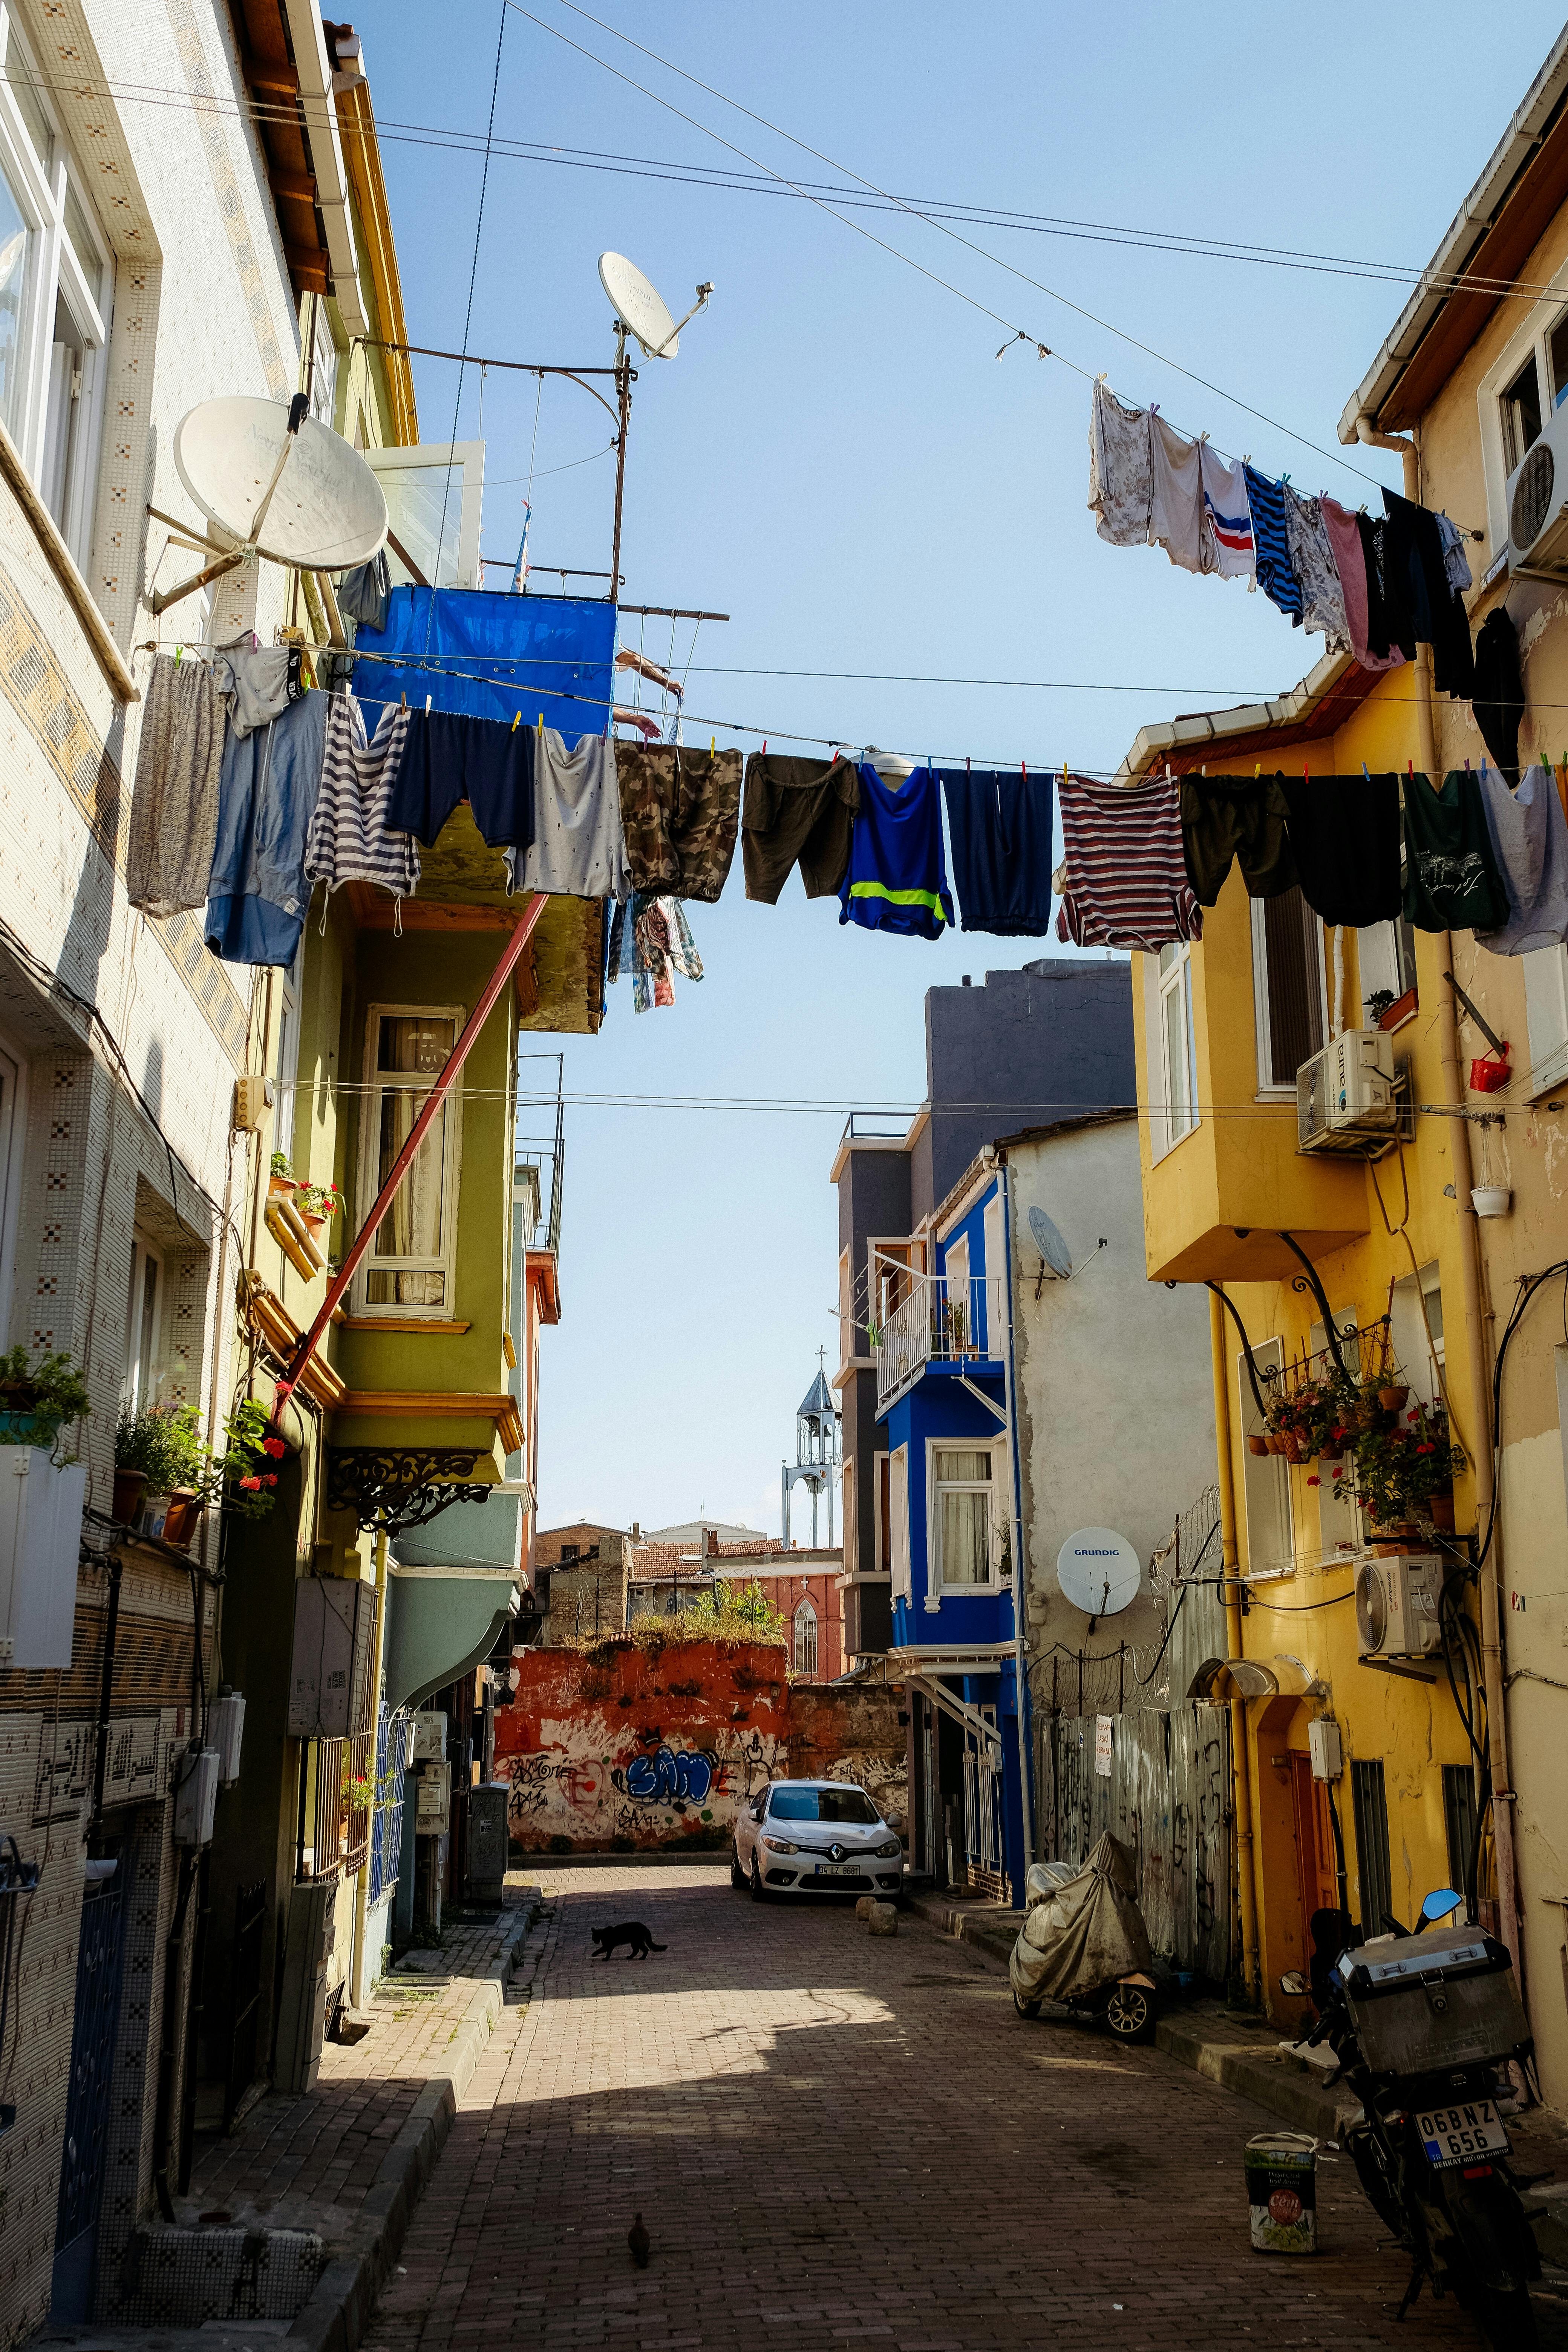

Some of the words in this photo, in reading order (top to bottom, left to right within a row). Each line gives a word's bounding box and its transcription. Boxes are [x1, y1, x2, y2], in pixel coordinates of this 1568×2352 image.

[819, 1866, 828, 1874] 34
[831, 1866, 839, 1874] LZ
[1447, 2128, 1488, 2155] 656
[1433, 2157, 1461, 2169] BERKAY
[1463, 2153, 1485, 2163] MOTOR
